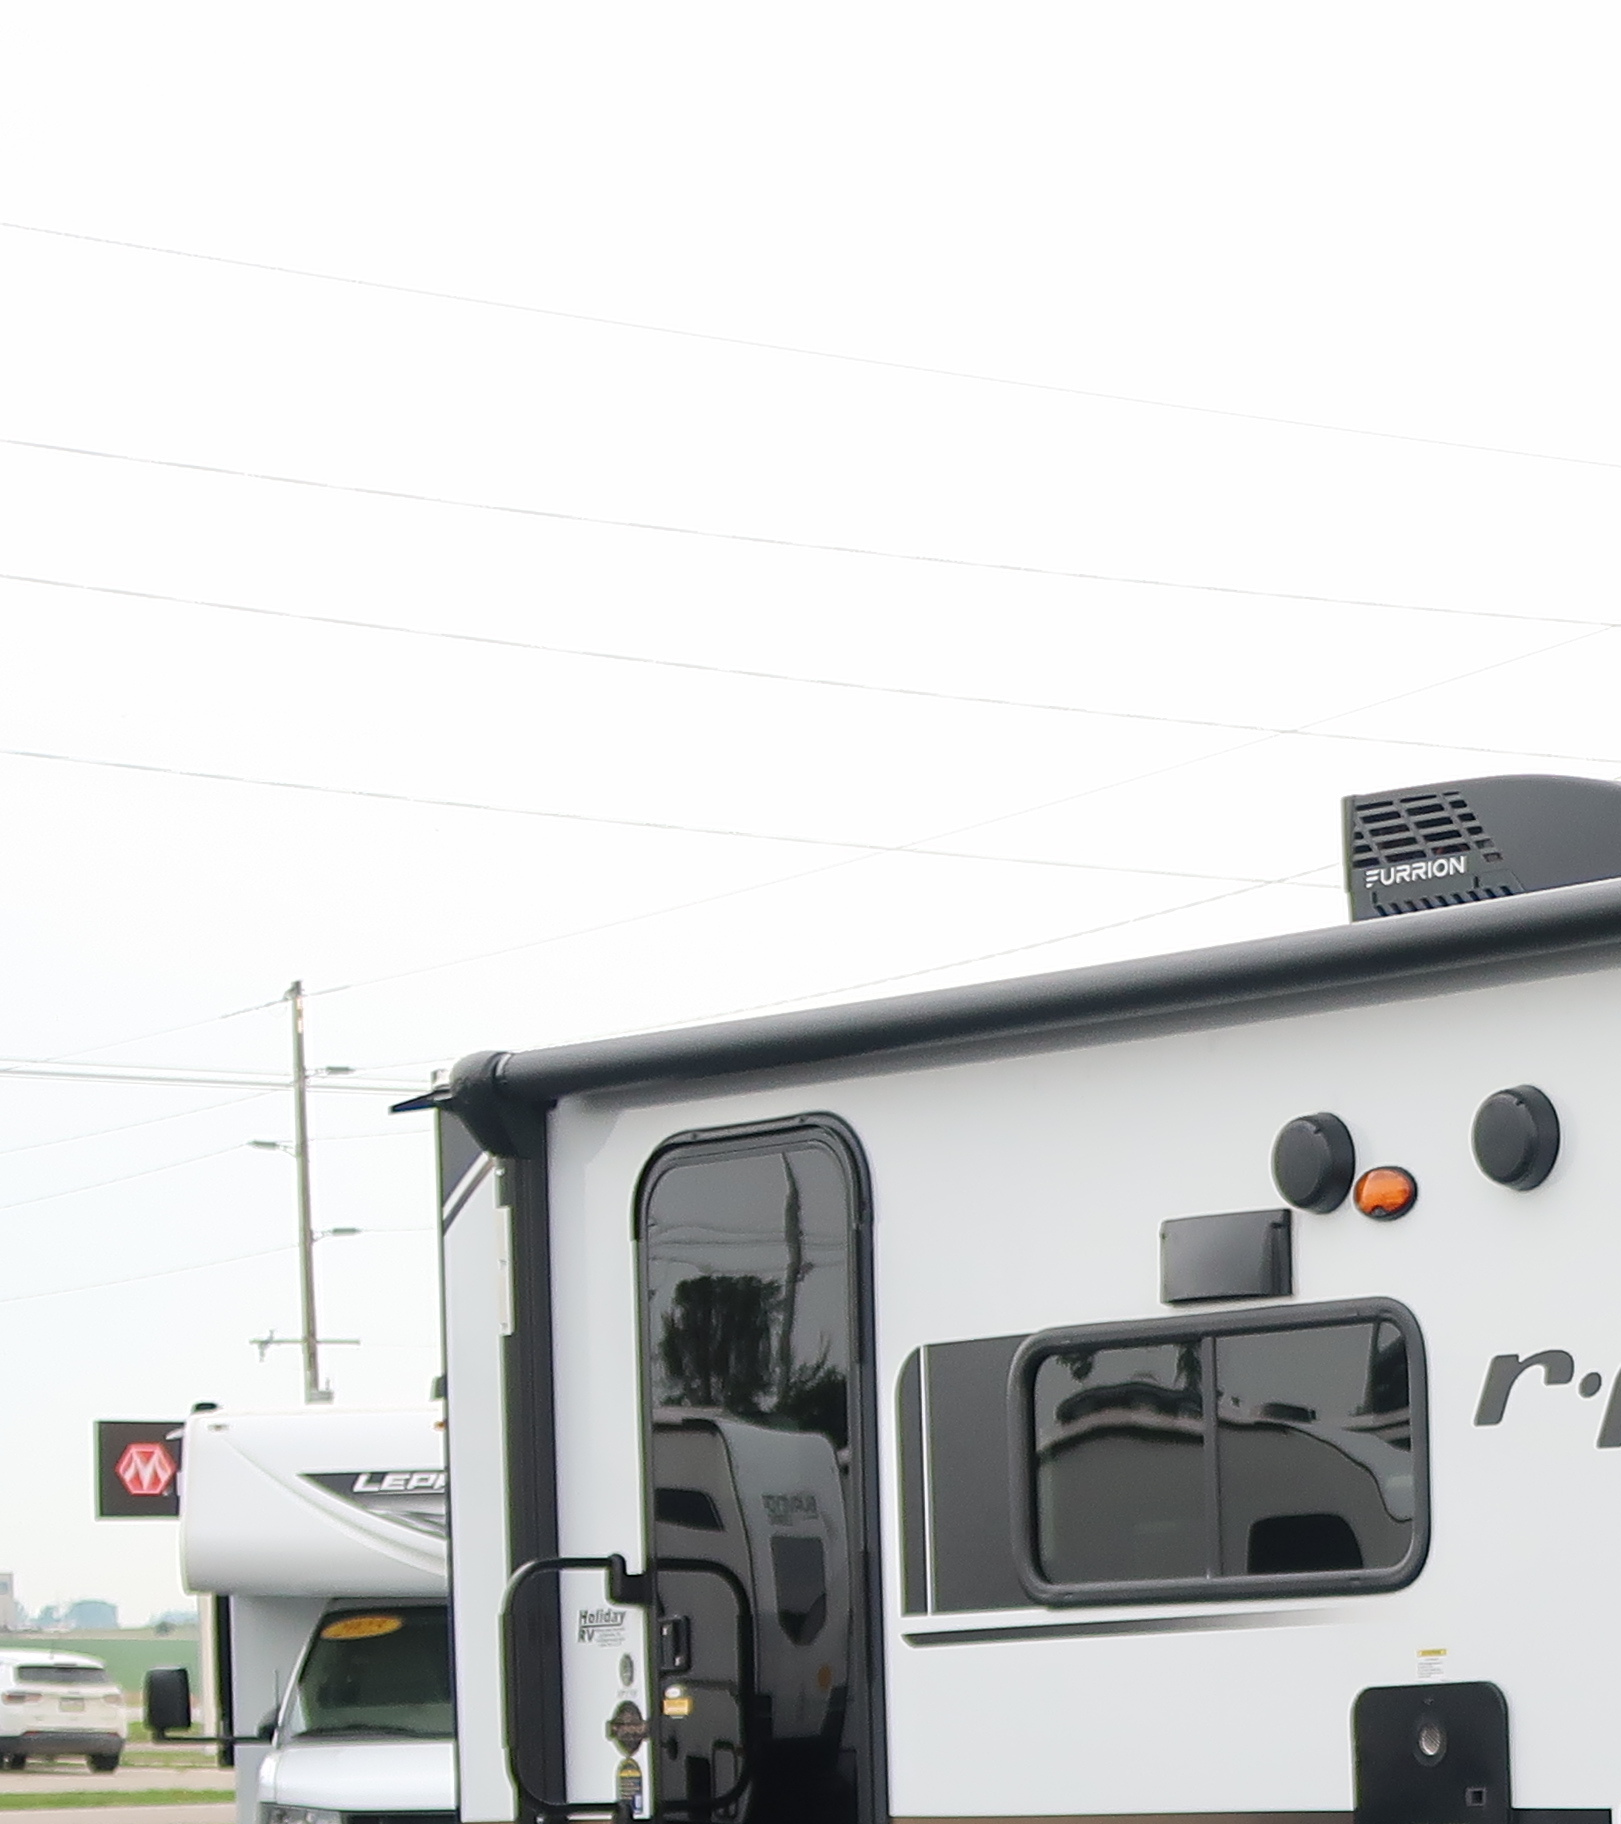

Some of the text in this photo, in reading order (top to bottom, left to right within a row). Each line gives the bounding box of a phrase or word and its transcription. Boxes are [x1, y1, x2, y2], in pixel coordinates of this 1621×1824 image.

[1366, 856, 1467, 888] FURRION
[579, 1609, 626, 1627] Holiday
[578, 1628, 595, 1643] RV
